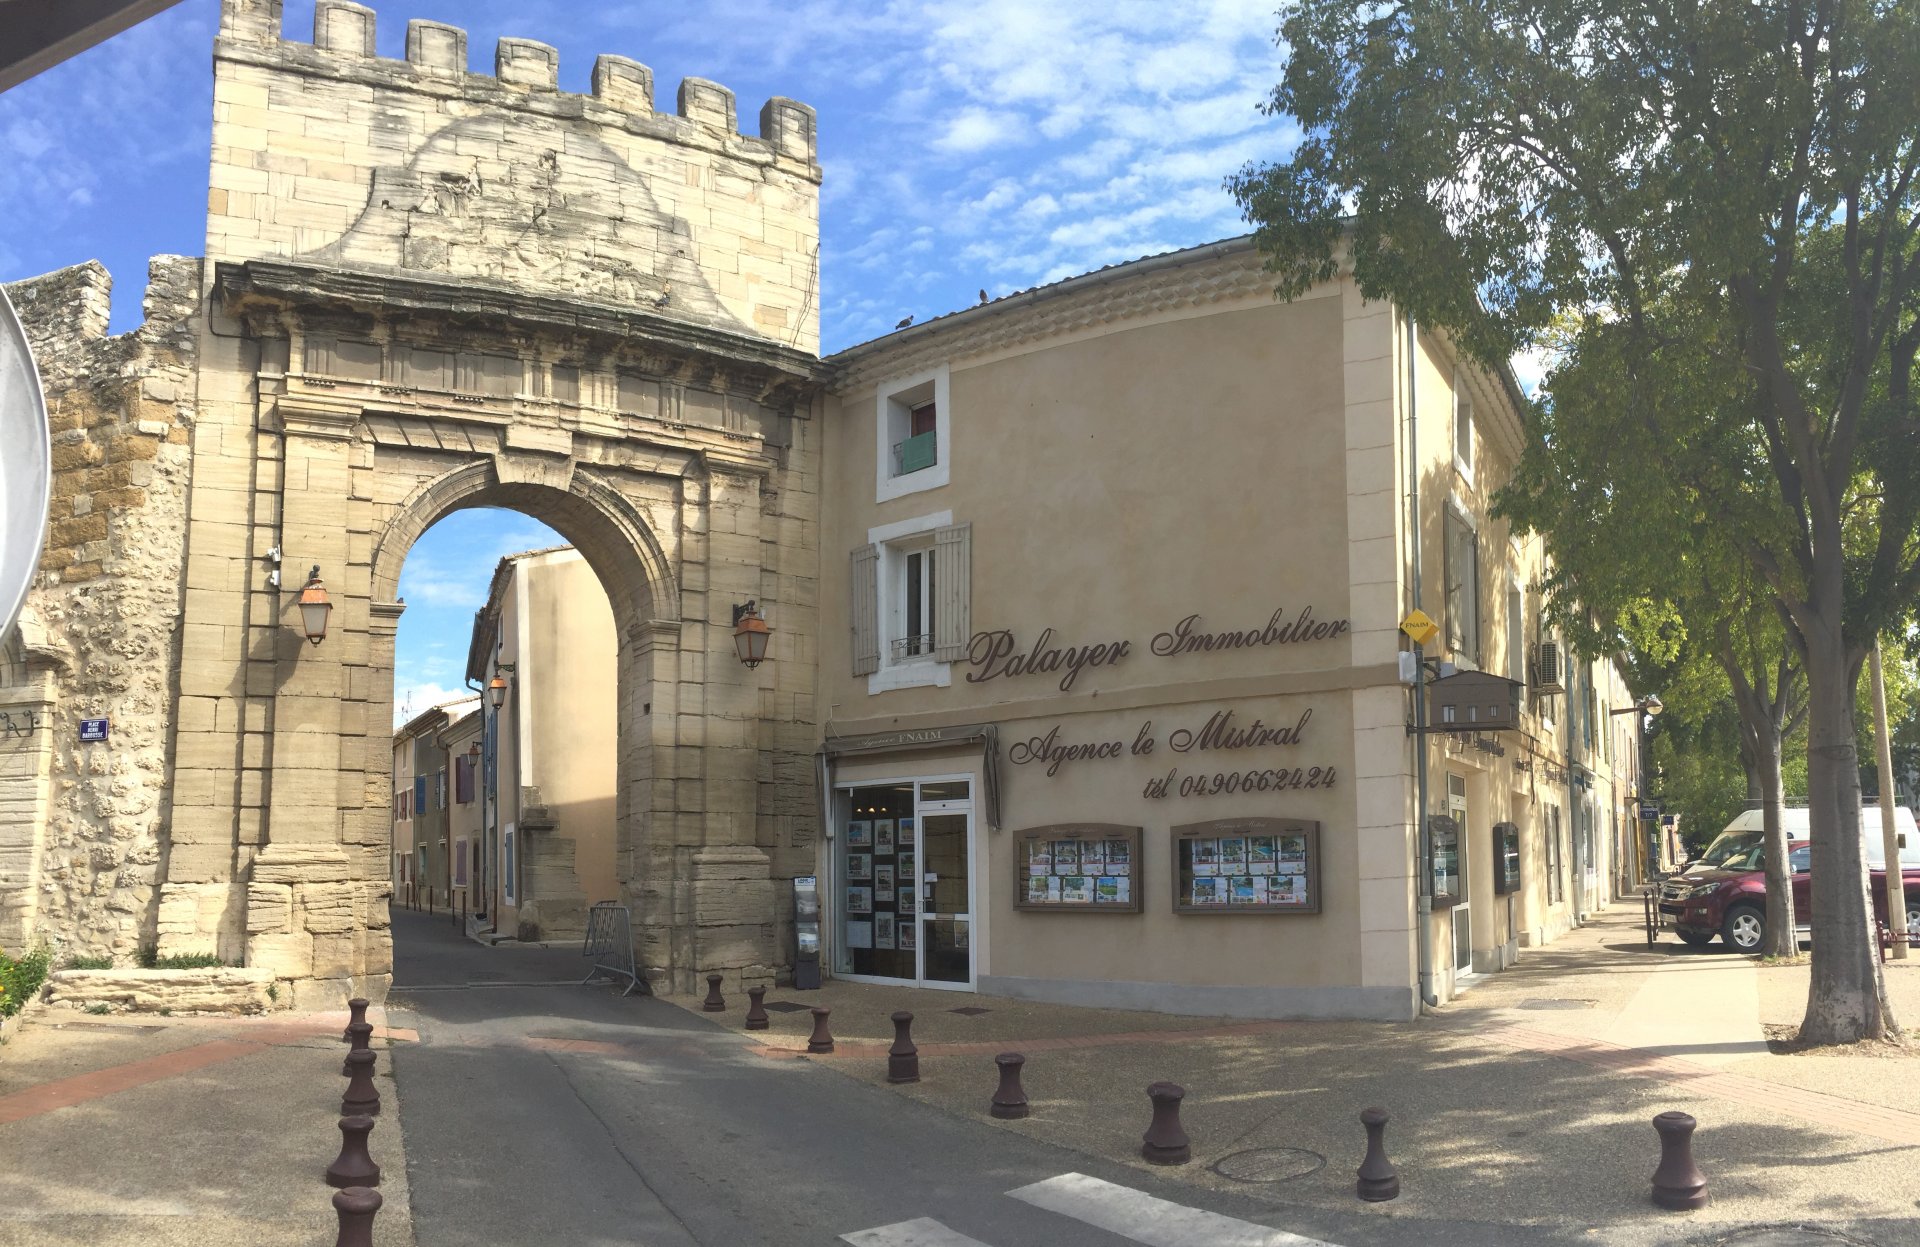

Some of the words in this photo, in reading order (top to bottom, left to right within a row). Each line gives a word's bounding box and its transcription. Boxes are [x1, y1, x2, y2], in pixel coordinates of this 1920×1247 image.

[965, 627, 1131, 692] Palayer
[1150, 605, 1350, 657] Immobilier
[899, 730, 941, 742] FNAIM
[1009, 725, 1122, 777] Agence
[1130, 720, 1154, 756] le
[1169, 708, 1313, 753] Mistral
[1179, 765, 1337, 798] 0490662424
